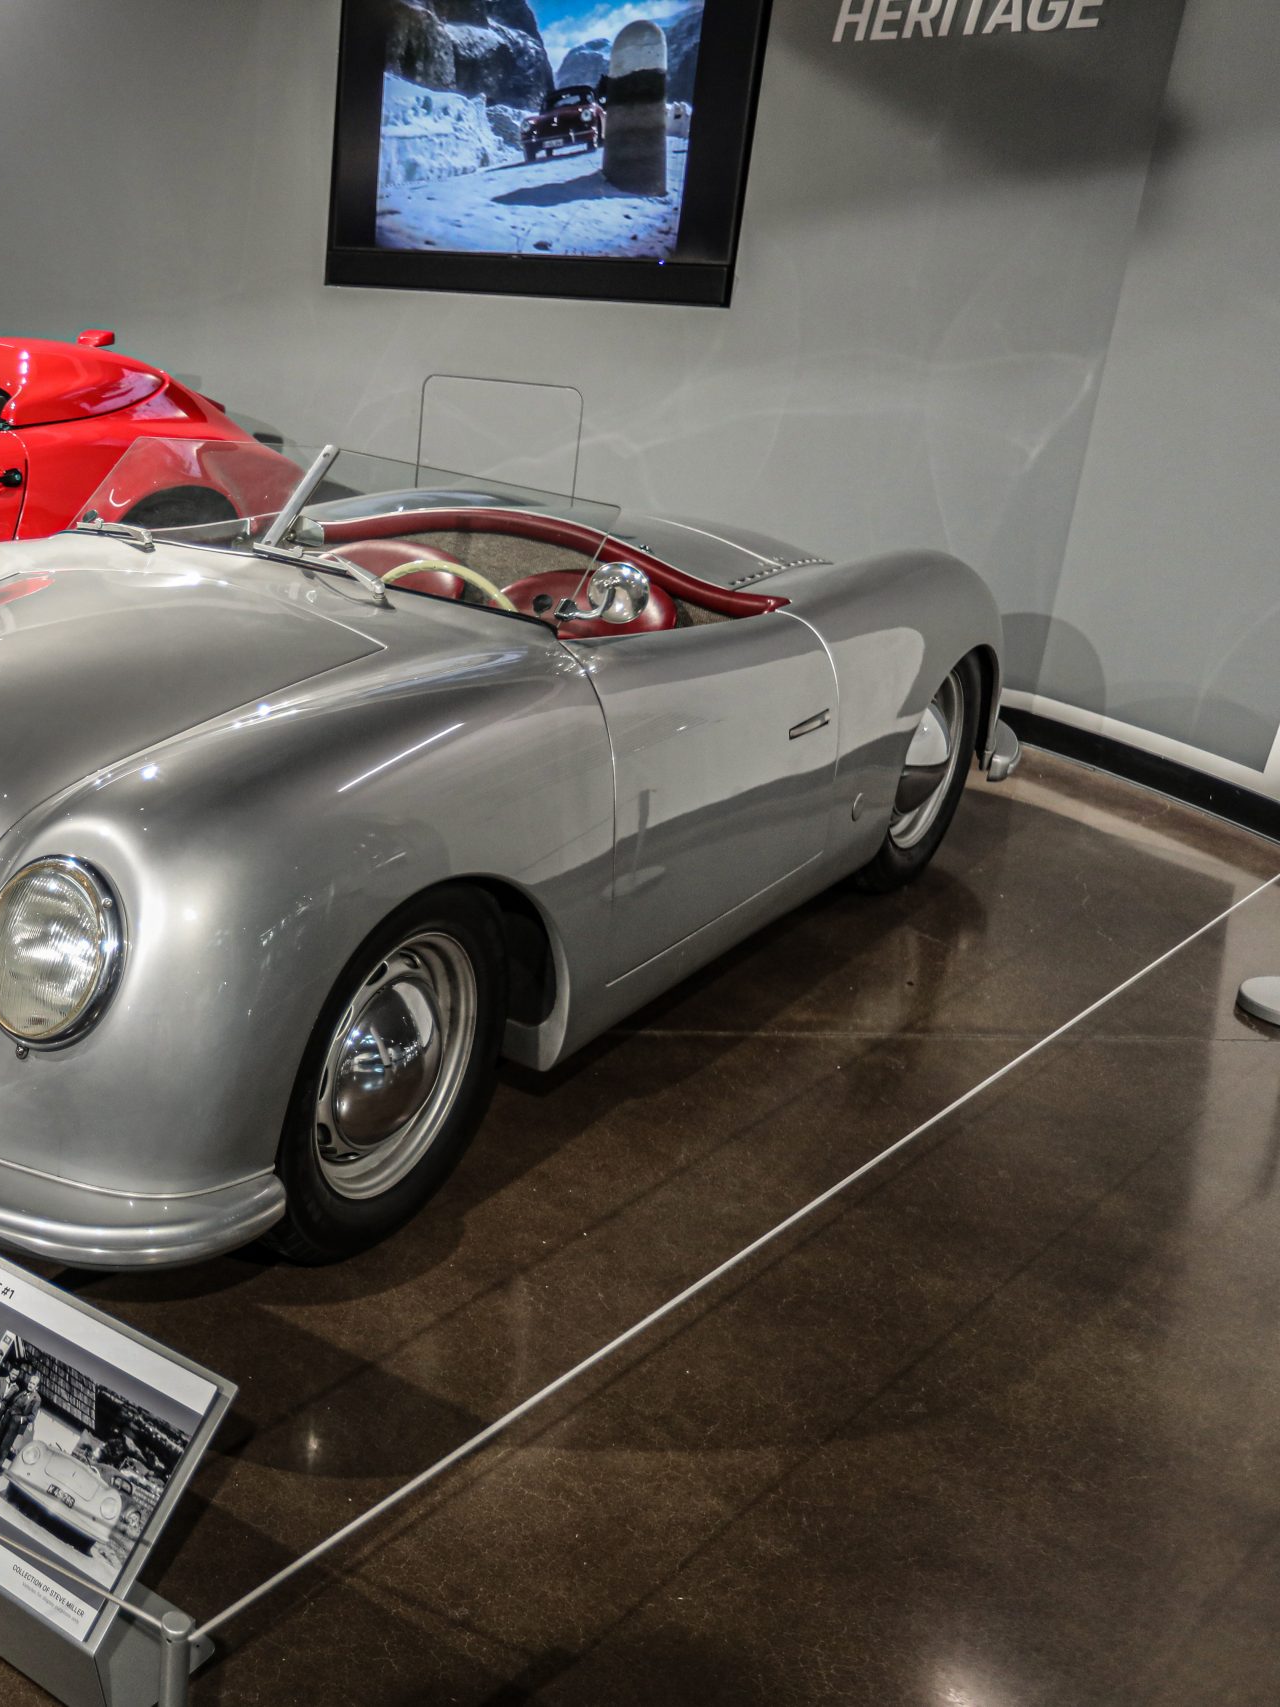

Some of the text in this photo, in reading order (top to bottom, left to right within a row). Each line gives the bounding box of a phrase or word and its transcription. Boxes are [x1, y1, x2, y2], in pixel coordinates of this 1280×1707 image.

[0, 1286, 14, 1299] #1
[12, 1564, 85, 1618] COLLECTION OF STEVE MILLER
